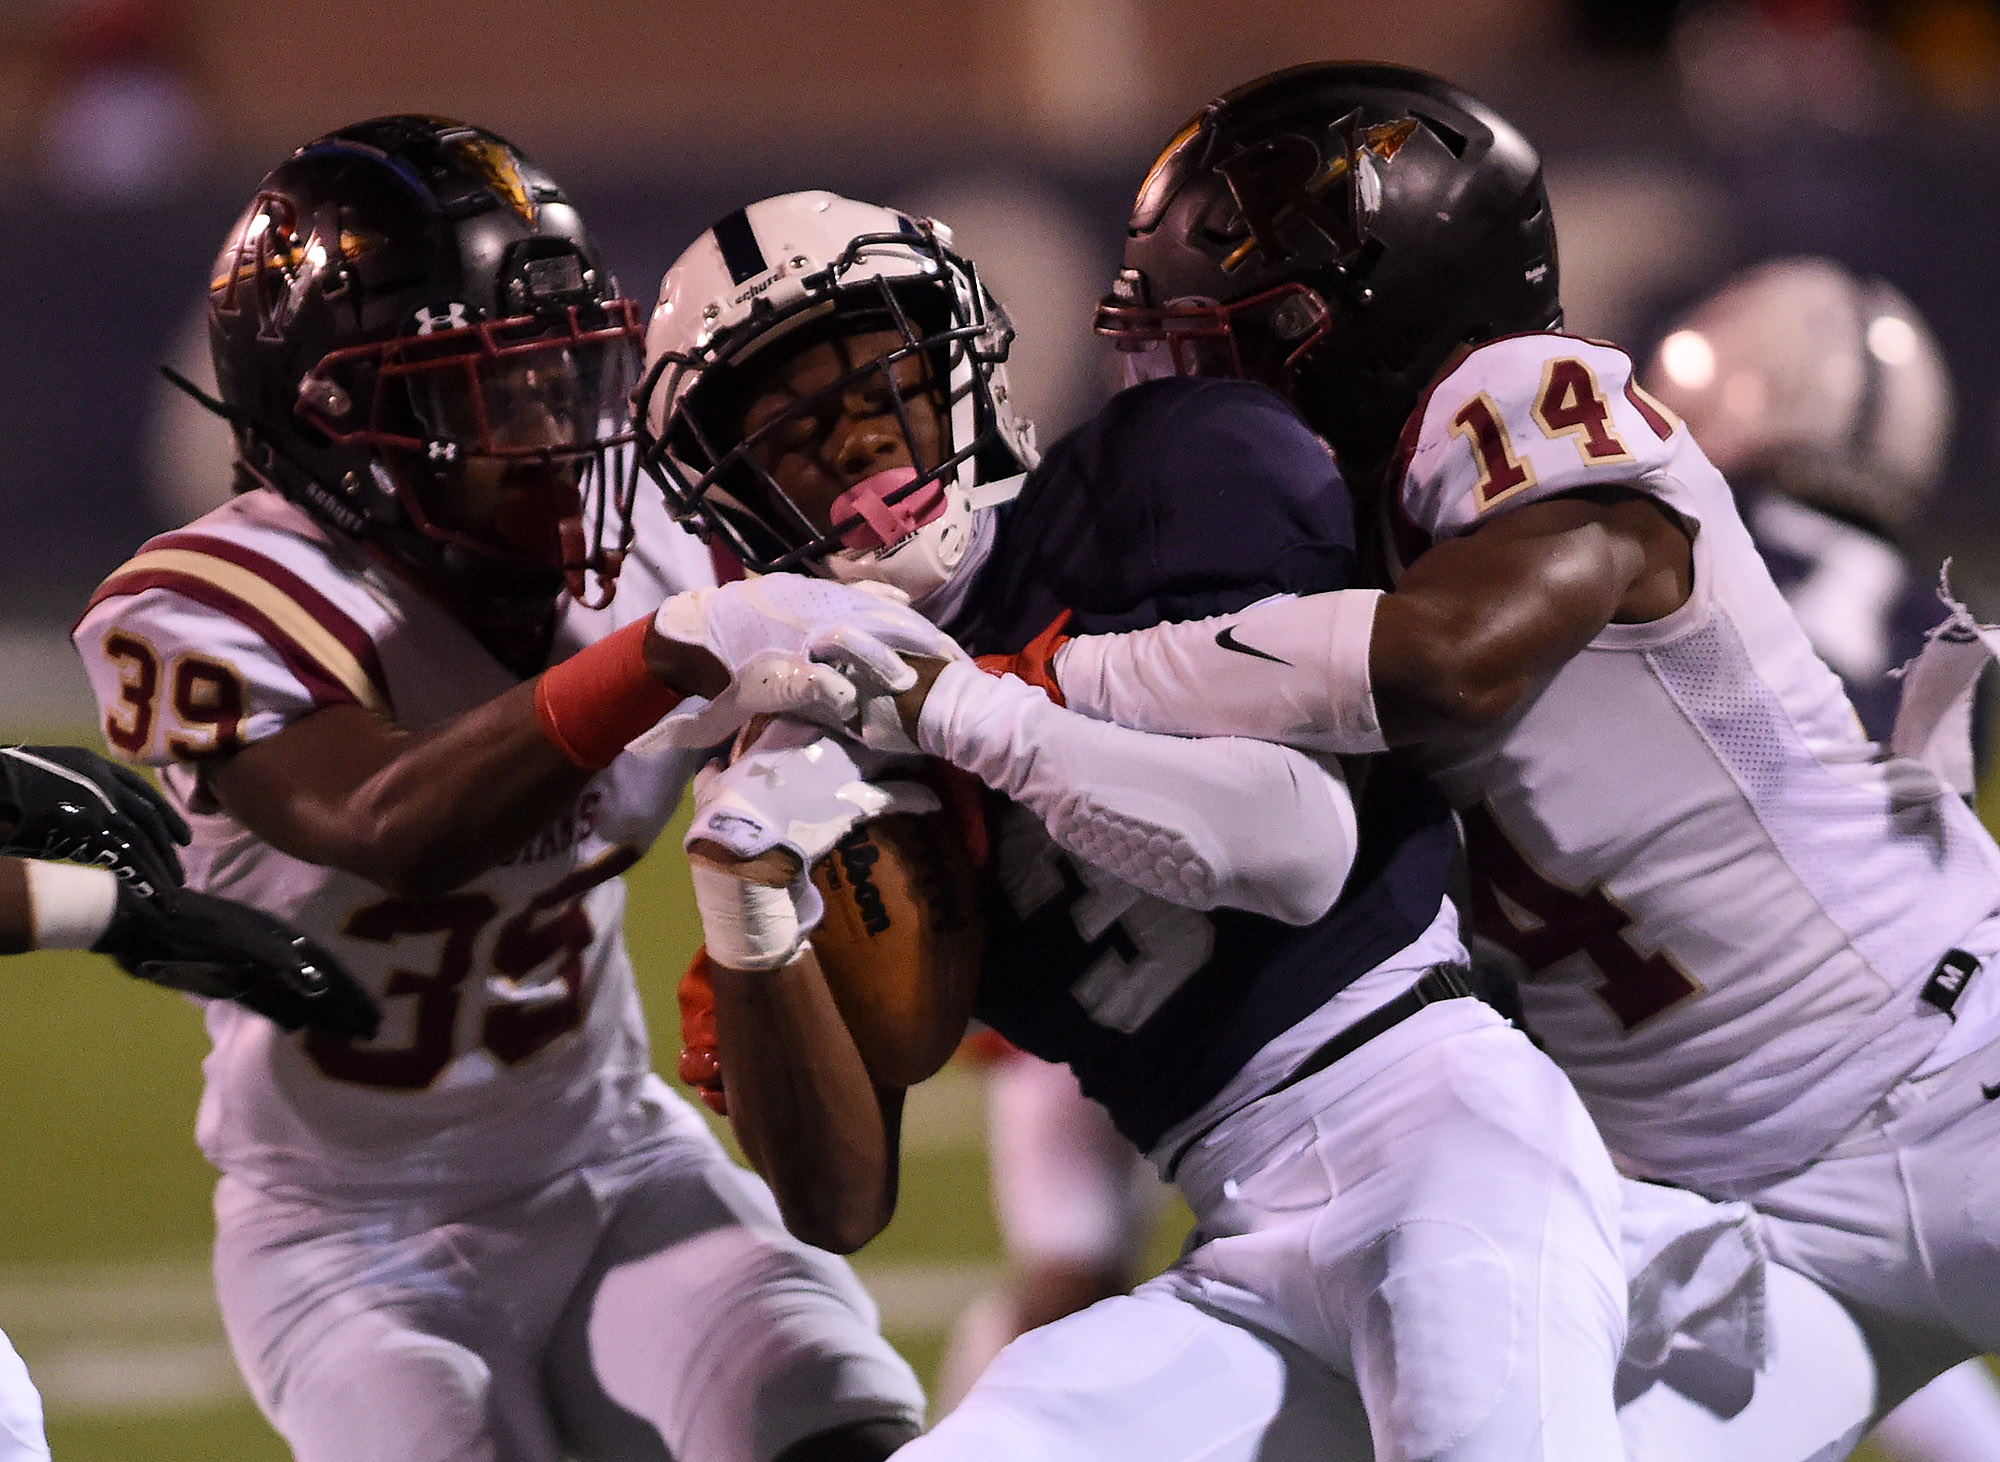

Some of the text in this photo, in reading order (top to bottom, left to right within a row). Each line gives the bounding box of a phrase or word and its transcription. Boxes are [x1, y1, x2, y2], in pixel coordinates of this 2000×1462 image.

[1447, 355, 1638, 514] 14
[101, 628, 248, 763] 39
[1935, 962, 1966, 992] M
